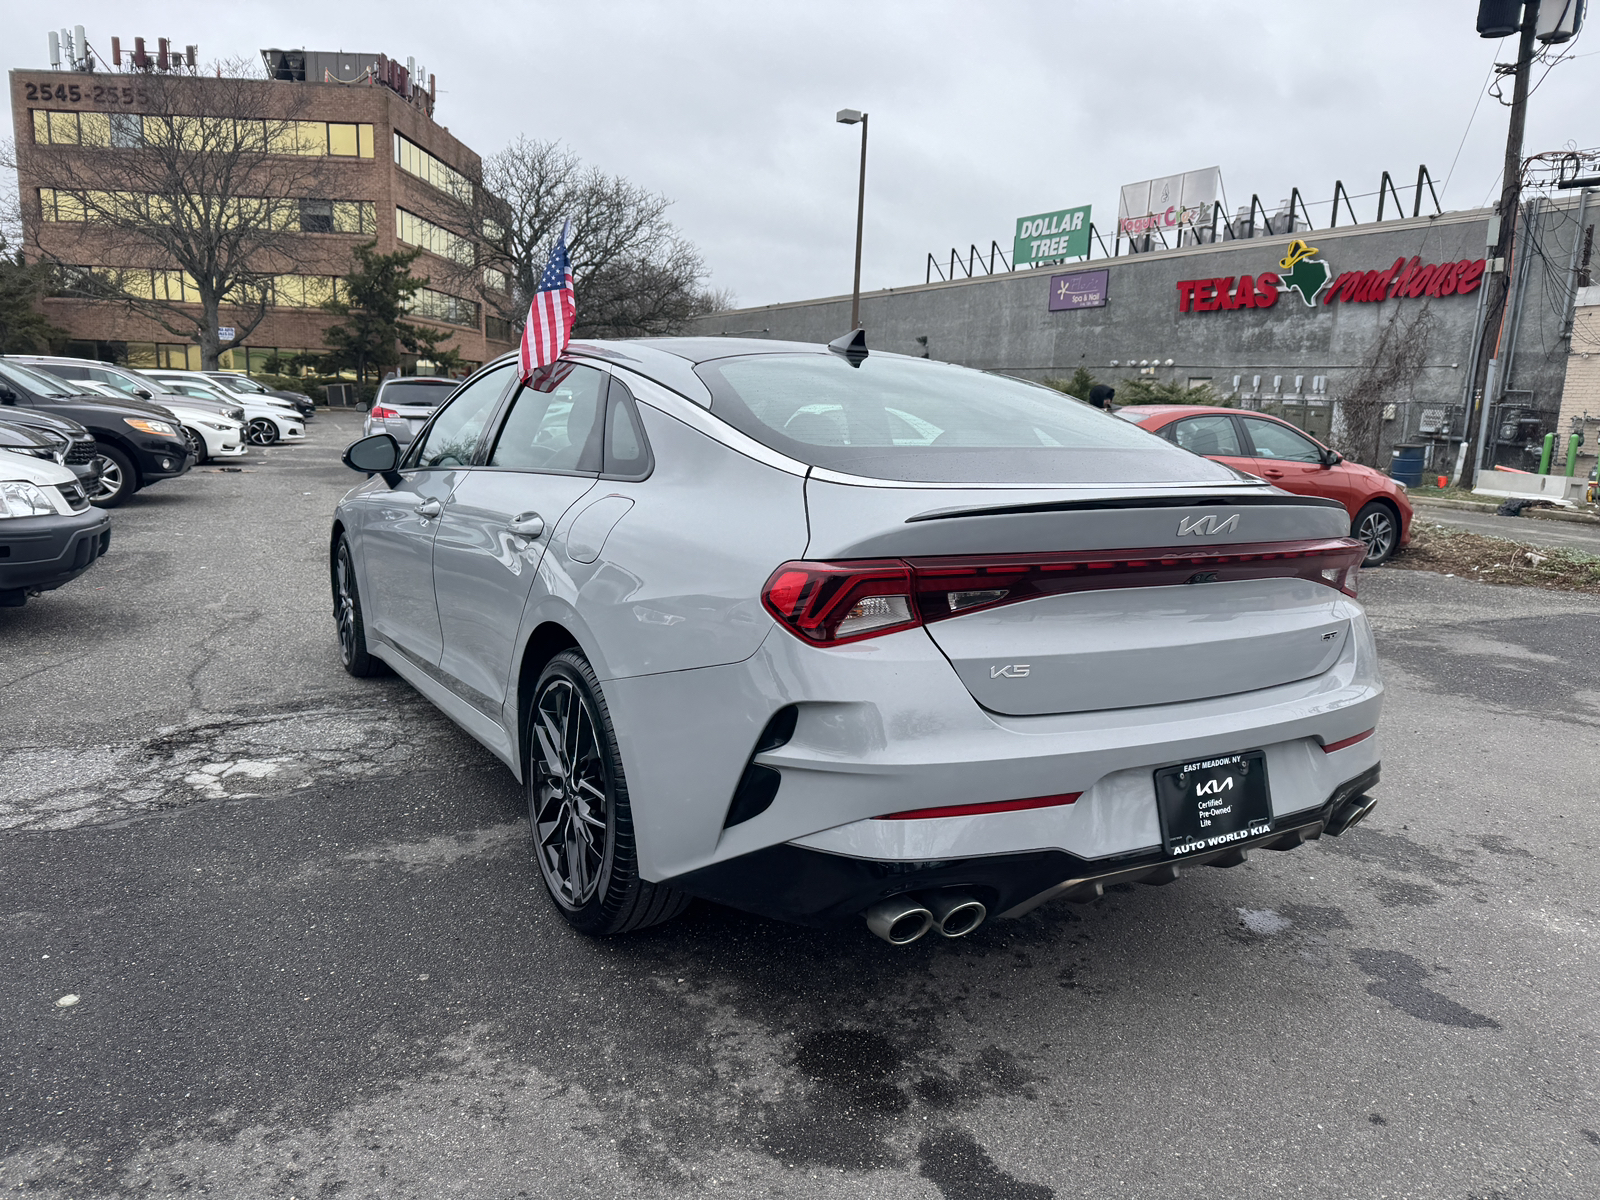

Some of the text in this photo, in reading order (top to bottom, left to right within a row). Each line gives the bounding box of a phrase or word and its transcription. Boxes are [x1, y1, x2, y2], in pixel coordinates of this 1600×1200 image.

[1020, 211, 1084, 239] DOLLAR
[1030, 235, 1070, 259] TREE
[1072, 295, 1083, 304] Spa
[1089, 292, 1100, 301] Nail
[1176, 272, 1279, 312] TEXAS
[1176, 513, 1240, 537] KIA
[990, 664, 1031, 679] K5
[1183, 763, 1201, 772] EAST
[1232, 755, 1241, 763] NY
[1196, 776, 1234, 797] KIA
[1198, 798, 1223, 809] Certified
[1199, 806, 1231, 819] Pre-Owned
[1173, 824, 1271, 856] AUTO WORLD KIA
